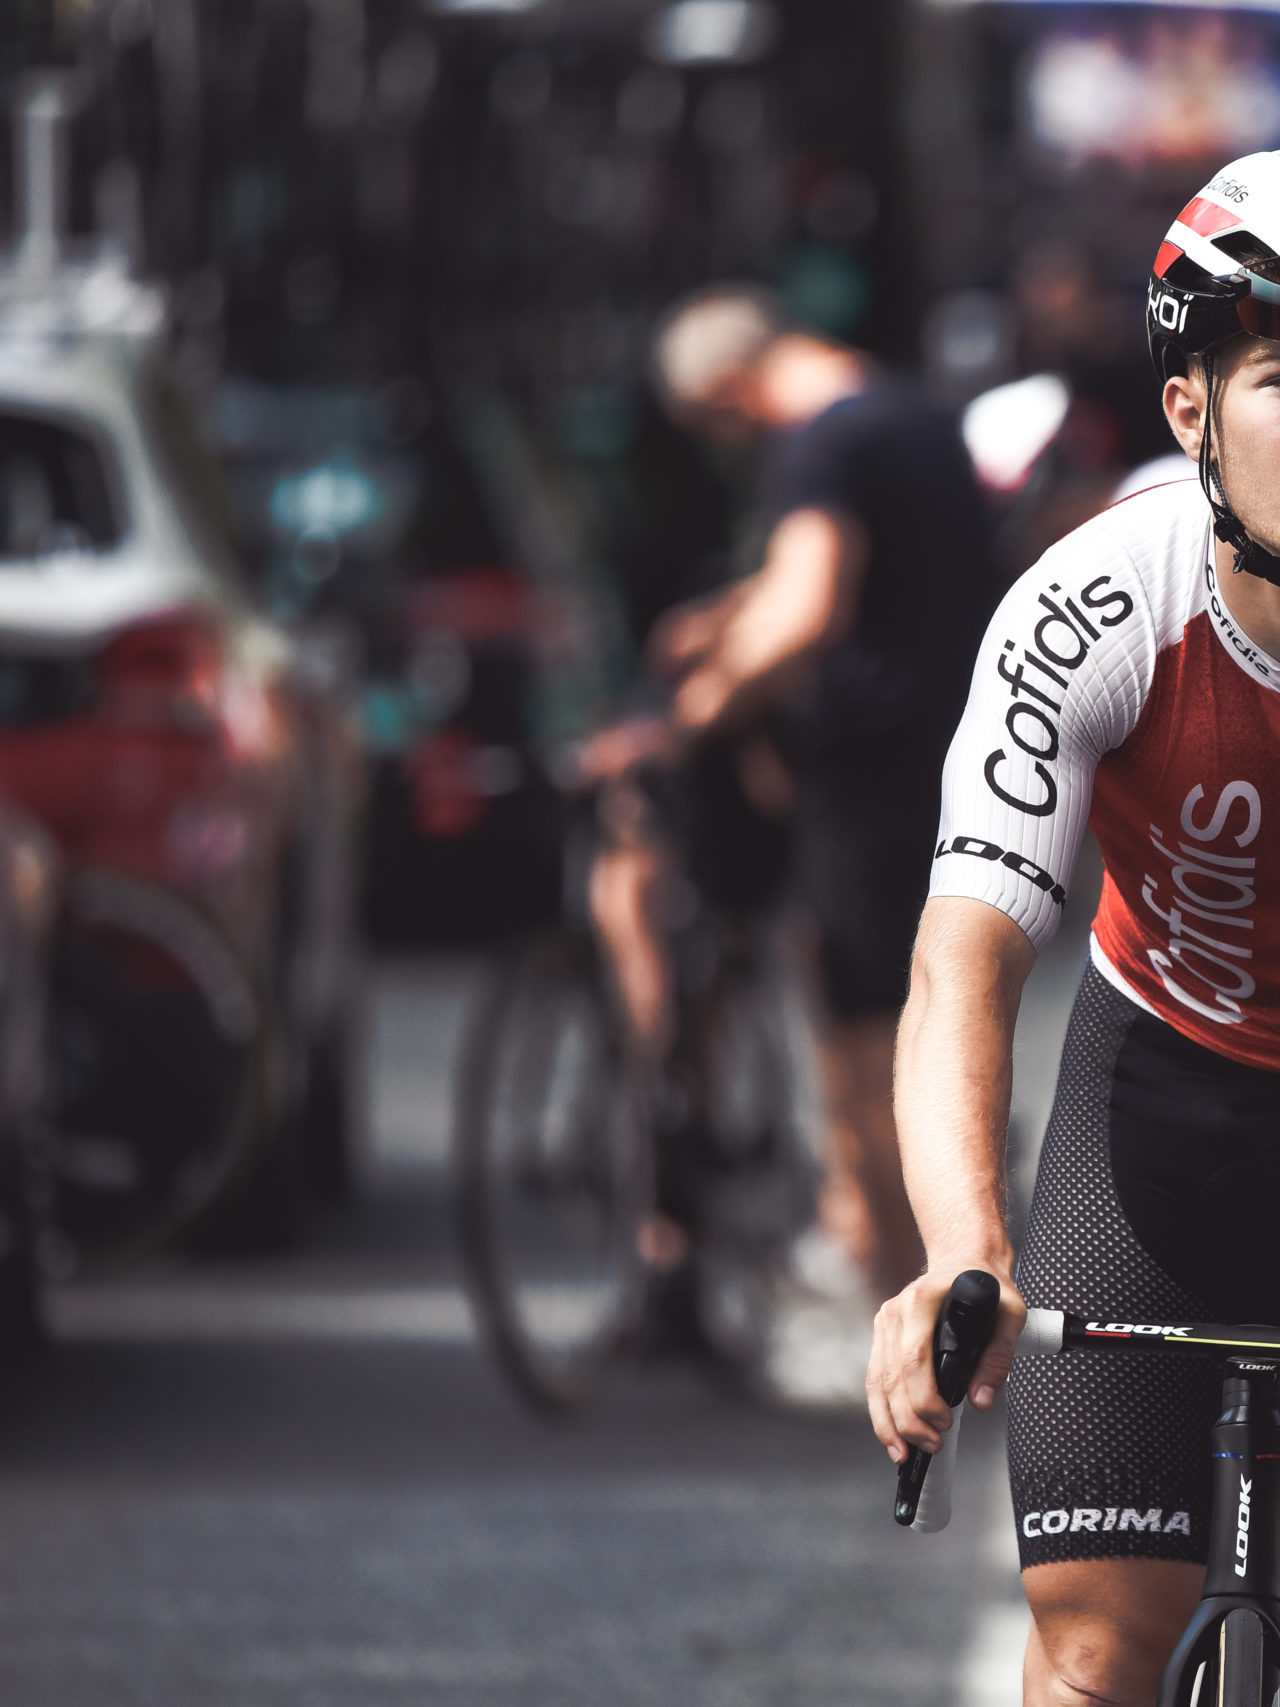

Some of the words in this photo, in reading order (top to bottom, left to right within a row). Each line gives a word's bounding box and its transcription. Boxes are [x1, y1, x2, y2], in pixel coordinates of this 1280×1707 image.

[1206, 564, 1270, 677] Cofidis
[983, 575, 1134, 818] Cofidis
[1141, 780, 1262, 1024] Cofidis
[1085, 1321, 1194, 1337] LOOK
[1239, 1363, 1277, 1371] LOOK
[1022, 1507, 1191, 1538] CORIMA
[1234, 1473, 1253, 1578] LOOK
